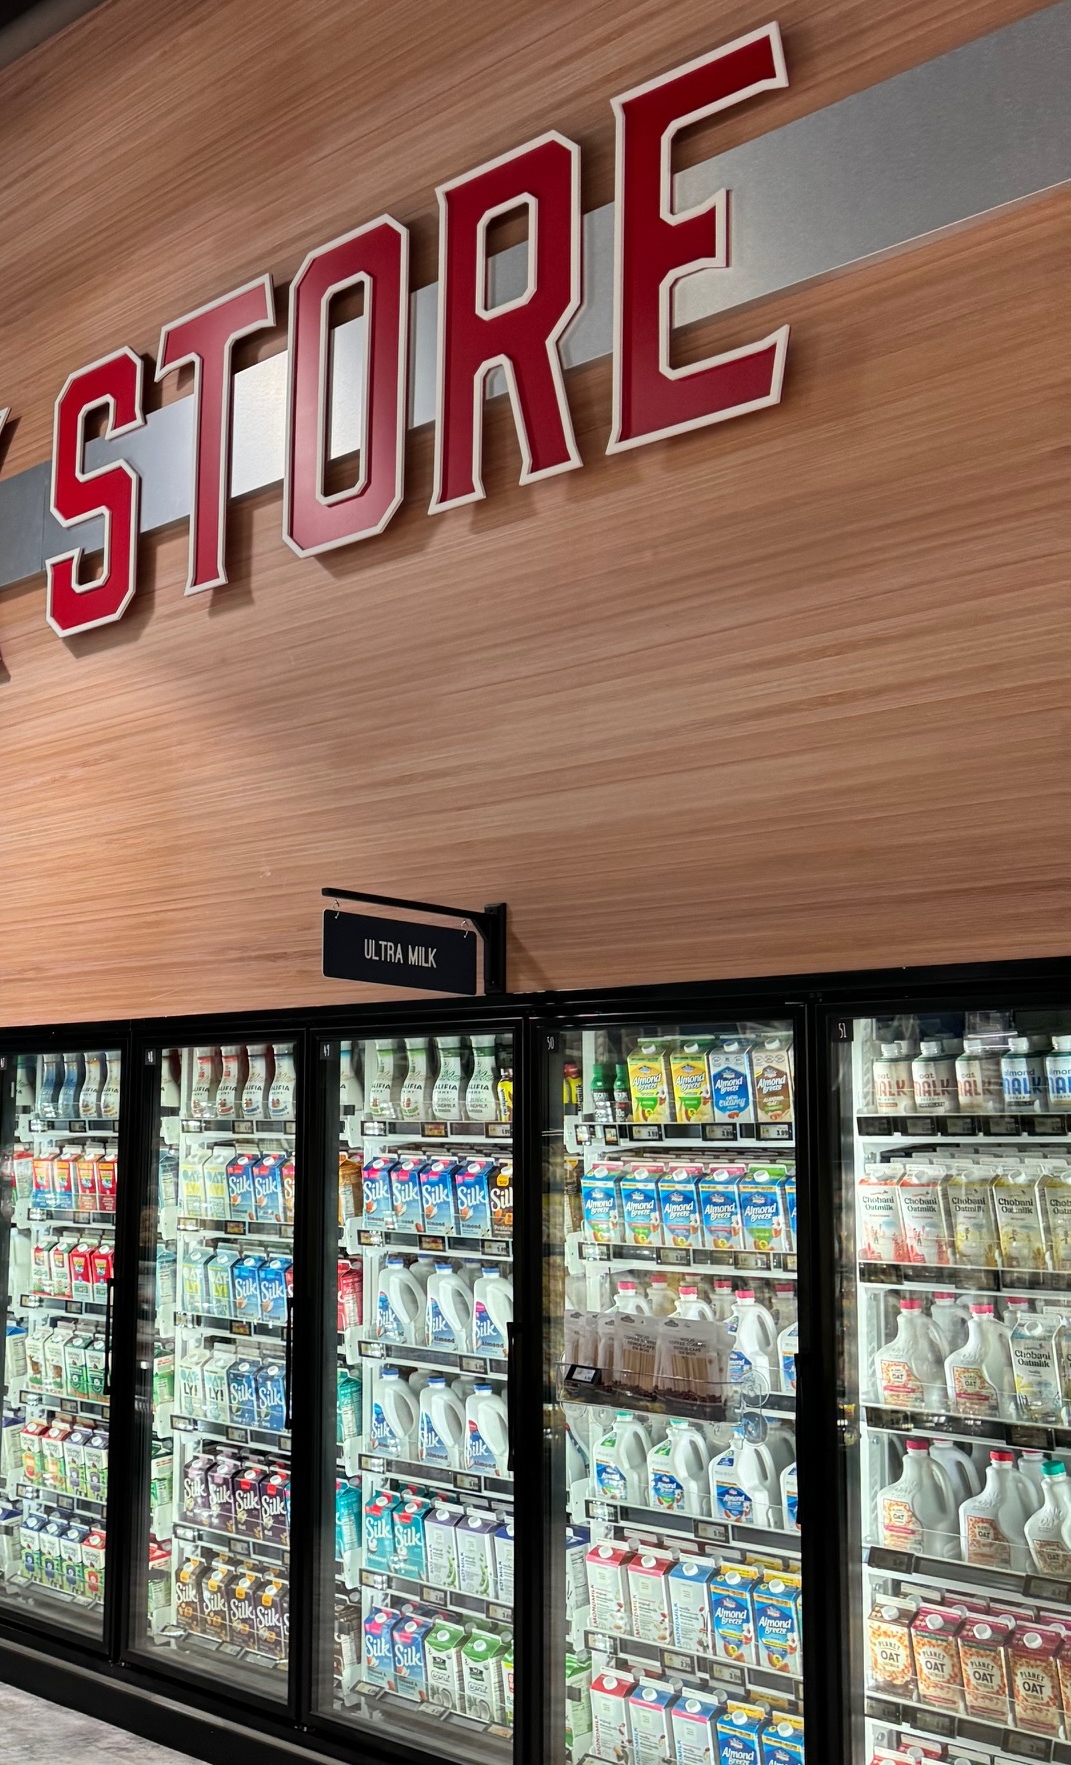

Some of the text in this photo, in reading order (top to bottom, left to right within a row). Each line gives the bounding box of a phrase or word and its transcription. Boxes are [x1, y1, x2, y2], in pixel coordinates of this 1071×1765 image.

[45, 21, 789, 637] STORE
[364, 938, 437, 968] ULTRA MILK
[838, 1022, 847, 1039] 51
[632, 1073, 662, 1087] Almond
[675, 1073, 705, 1087] Almond
[714, 1077, 743, 1091] Almond
[757, 1075, 786, 1090] Almond
[229, 1176, 251, 1195] Silk
[254, 1177, 279, 1198] Silk
[363, 1181, 390, 1203] Silk
[391, 1182, 419, 1206] Silk
[422, 1185, 449, 1208] Silk
[457, 1185, 488, 1209] Silk
[490, 1187, 513, 1212] Sil
[585, 1198, 613, 1209] Almond
[904, 1197, 937, 1205] Chobani
[952, 1196, 986, 1205] Chobani
[998, 1197, 1033, 1207] Chobani
[590, 1206, 610, 1215] Breeze
[625, 1200, 654, 1212] Almond
[631, 1208, 651, 1218] Breeze
[664, 1203, 694, 1214] Almond
[669, 1210, 690, 1219] Breeze
[705, 1203, 735, 1215] Almond
[744, 1205, 776, 1217] Almond
[711, 1212, 731, 1221] Breeze
[751, 1213, 772, 1223] Breeze
[235, 1278, 259, 1299] Silk
[261, 1281, 286, 1302] Silk
[378, 1307, 396, 1327] Silk
[425, 1314, 447, 1333] Silk
[475, 1319, 497, 1338] Silk
[1015, 1350, 1051, 1360] Chobani
[183, 1382, 198, 1397] LY!
[208, 1387, 224, 1401] LY!
[230, 1382, 255, 1405] Silk
[259, 1387, 285, 1409] Silk
[371, 1422, 392, 1439] Silk
[466, 1438, 487, 1458] Silk
[184, 1478, 207, 1499] Silk
[209, 1485, 233, 1506] Silk
[236, 1490, 261, 1512] Silk
[261, 1495, 286, 1517] Silk
[365, 1517, 392, 1540] Silk
[394, 1525, 423, 1548] Silk
[176, 1582, 199, 1604] Silk
[204, 1592, 228, 1613] Silk
[230, 1599, 255, 1621] Silk
[590, 1584, 598, 1628] LMONDMILK
[257, 1606, 282, 1628] Silk
[633, 1594, 641, 1638] LMONDMILK
[715, 1607, 747, 1620] Almond
[721, 1616, 743, 1626] Breeze
[673, 1602, 682, 1648] LMONDMILK
[759, 1616, 791, 1629] Almond
[765, 1625, 787, 1635] Breeze
[365, 1634, 391, 1657] Silk
[878, 1641, 901, 1650] PLANET
[394, 1644, 423, 1668] Silk
[880, 1650, 901, 1664] OAT
[922, 1650, 945, 1661] PLANET
[925, 1659, 945, 1674] OAT
[970, 1661, 995, 1671] PLANET
[973, 1670, 995, 1685] OAT
[1020, 1671, 1045, 1682] PLANET
[1023, 1681, 1045, 1696] OAT
[594, 1715, 602, 1755] MONDMILK
[722, 1747, 755, 1761] Almond
